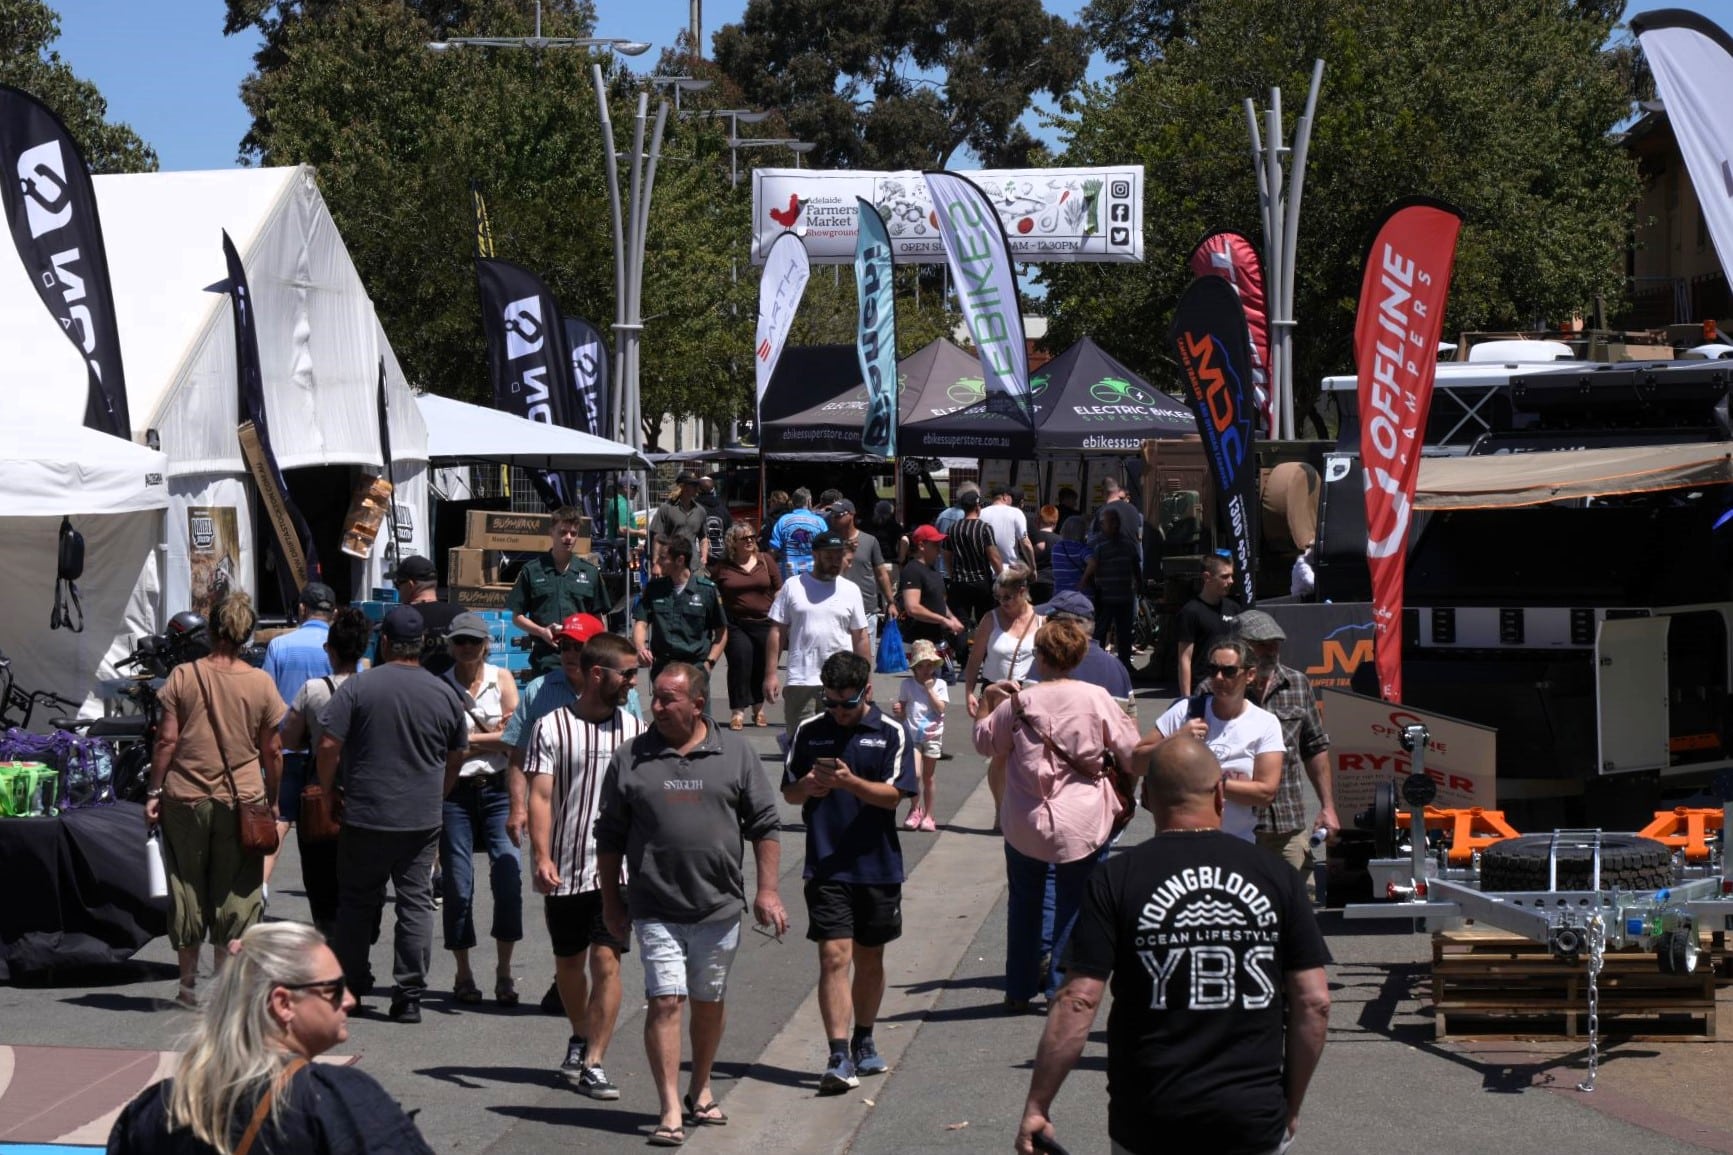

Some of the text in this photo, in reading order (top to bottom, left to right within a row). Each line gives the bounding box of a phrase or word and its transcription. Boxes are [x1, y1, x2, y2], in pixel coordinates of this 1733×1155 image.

[806, 196, 842, 204] Adelaide
[806, 205, 858, 215] Farmers
[806, 216, 852, 227] Market
[900, 242, 930, 252] OPEN
[1008, 241, 1029, 251] AM
[1370, 243, 1416, 460] OFFLINE
[1073, 405, 1195, 420] ELECTRIC BIKES
[1082, 415, 1192, 424] SUPERSTOR
[922, 430, 1010, 447] ebikessuperstore.com.au
[1228, 495, 1243, 537] 1300
[1338, 753, 1475, 793] RYDER
[1137, 866, 1278, 931] YOUNGBLOODS
[1135, 930, 1280, 946] OCEAN LIFESTYLE
[1137, 945, 1276, 1010] YBS
